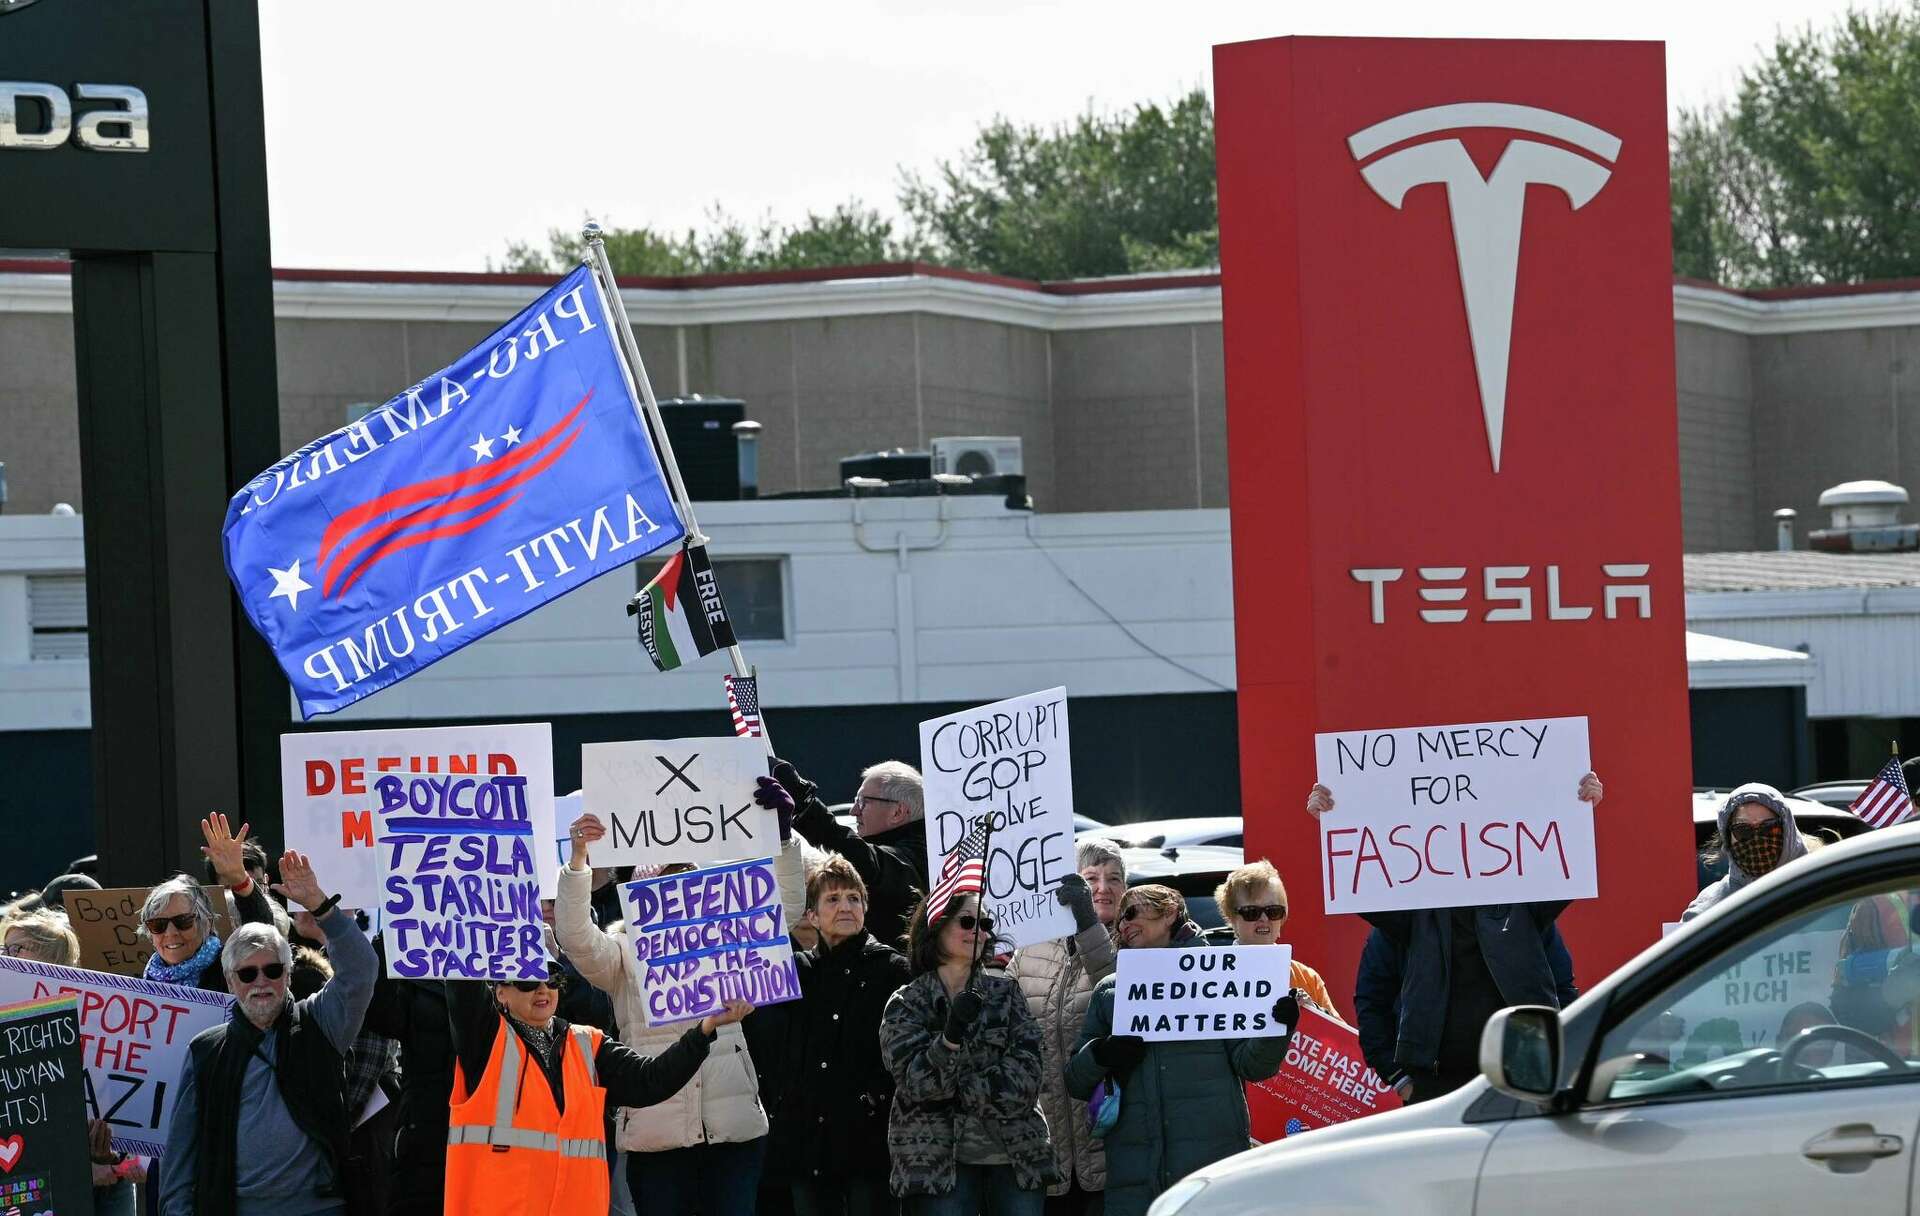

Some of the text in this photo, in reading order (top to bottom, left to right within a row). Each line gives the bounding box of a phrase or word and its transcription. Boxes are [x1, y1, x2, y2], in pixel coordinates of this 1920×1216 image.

[696, 569, 725, 625] FREE
[1350, 563, 1651, 624] TESLA
[638, 592, 659, 660] ALESTINE
[931, 699, 1065, 773] CORRUPT
[1336, 724, 1548, 775] NO MERCY
[655, 753, 701, 796] X
[962, 750, 1047, 802] GOP
[1410, 774, 1478, 806] FOR
[374, 775, 528, 821] BOYCOTT
[611, 803, 753, 849] MUSK
[378, 835, 534, 877] TESLA
[986, 831, 1064, 900] OGE
[1326, 821, 1570, 901] FASCISM
[74, 894, 135, 922] Bad
[628, 865, 776, 926] DEFEND
[986, 887, 1058, 929] ORRUPT
[635, 904, 782, 961] DEMOCRACY
[102, 950, 150, 967] ELO
[393, 949, 549, 980] SPACE-X
[644, 949, 763, 990] AND THE
[1178, 953, 1237, 972] OUR
[1763, 950, 1812, 977] THE
[1128, 980, 1272, 1001] MEDICAID
[1724, 980, 1788, 1006] RICH
[3, 1016, 76, 1056] RIGHTS
[1130, 1013, 1267, 1033] MATTERS
[80, 1033, 152, 1075] THE
[1291, 1031, 1323, 1058] ATE
[1322, 1047, 1361, 1078] HAS
[82, 1067, 167, 1130] AZI
[1285, 1049, 1328, 1081] OME
[1328, 1070, 1377, 1109] HERE.
[28, 1178, 44, 1190] NO
